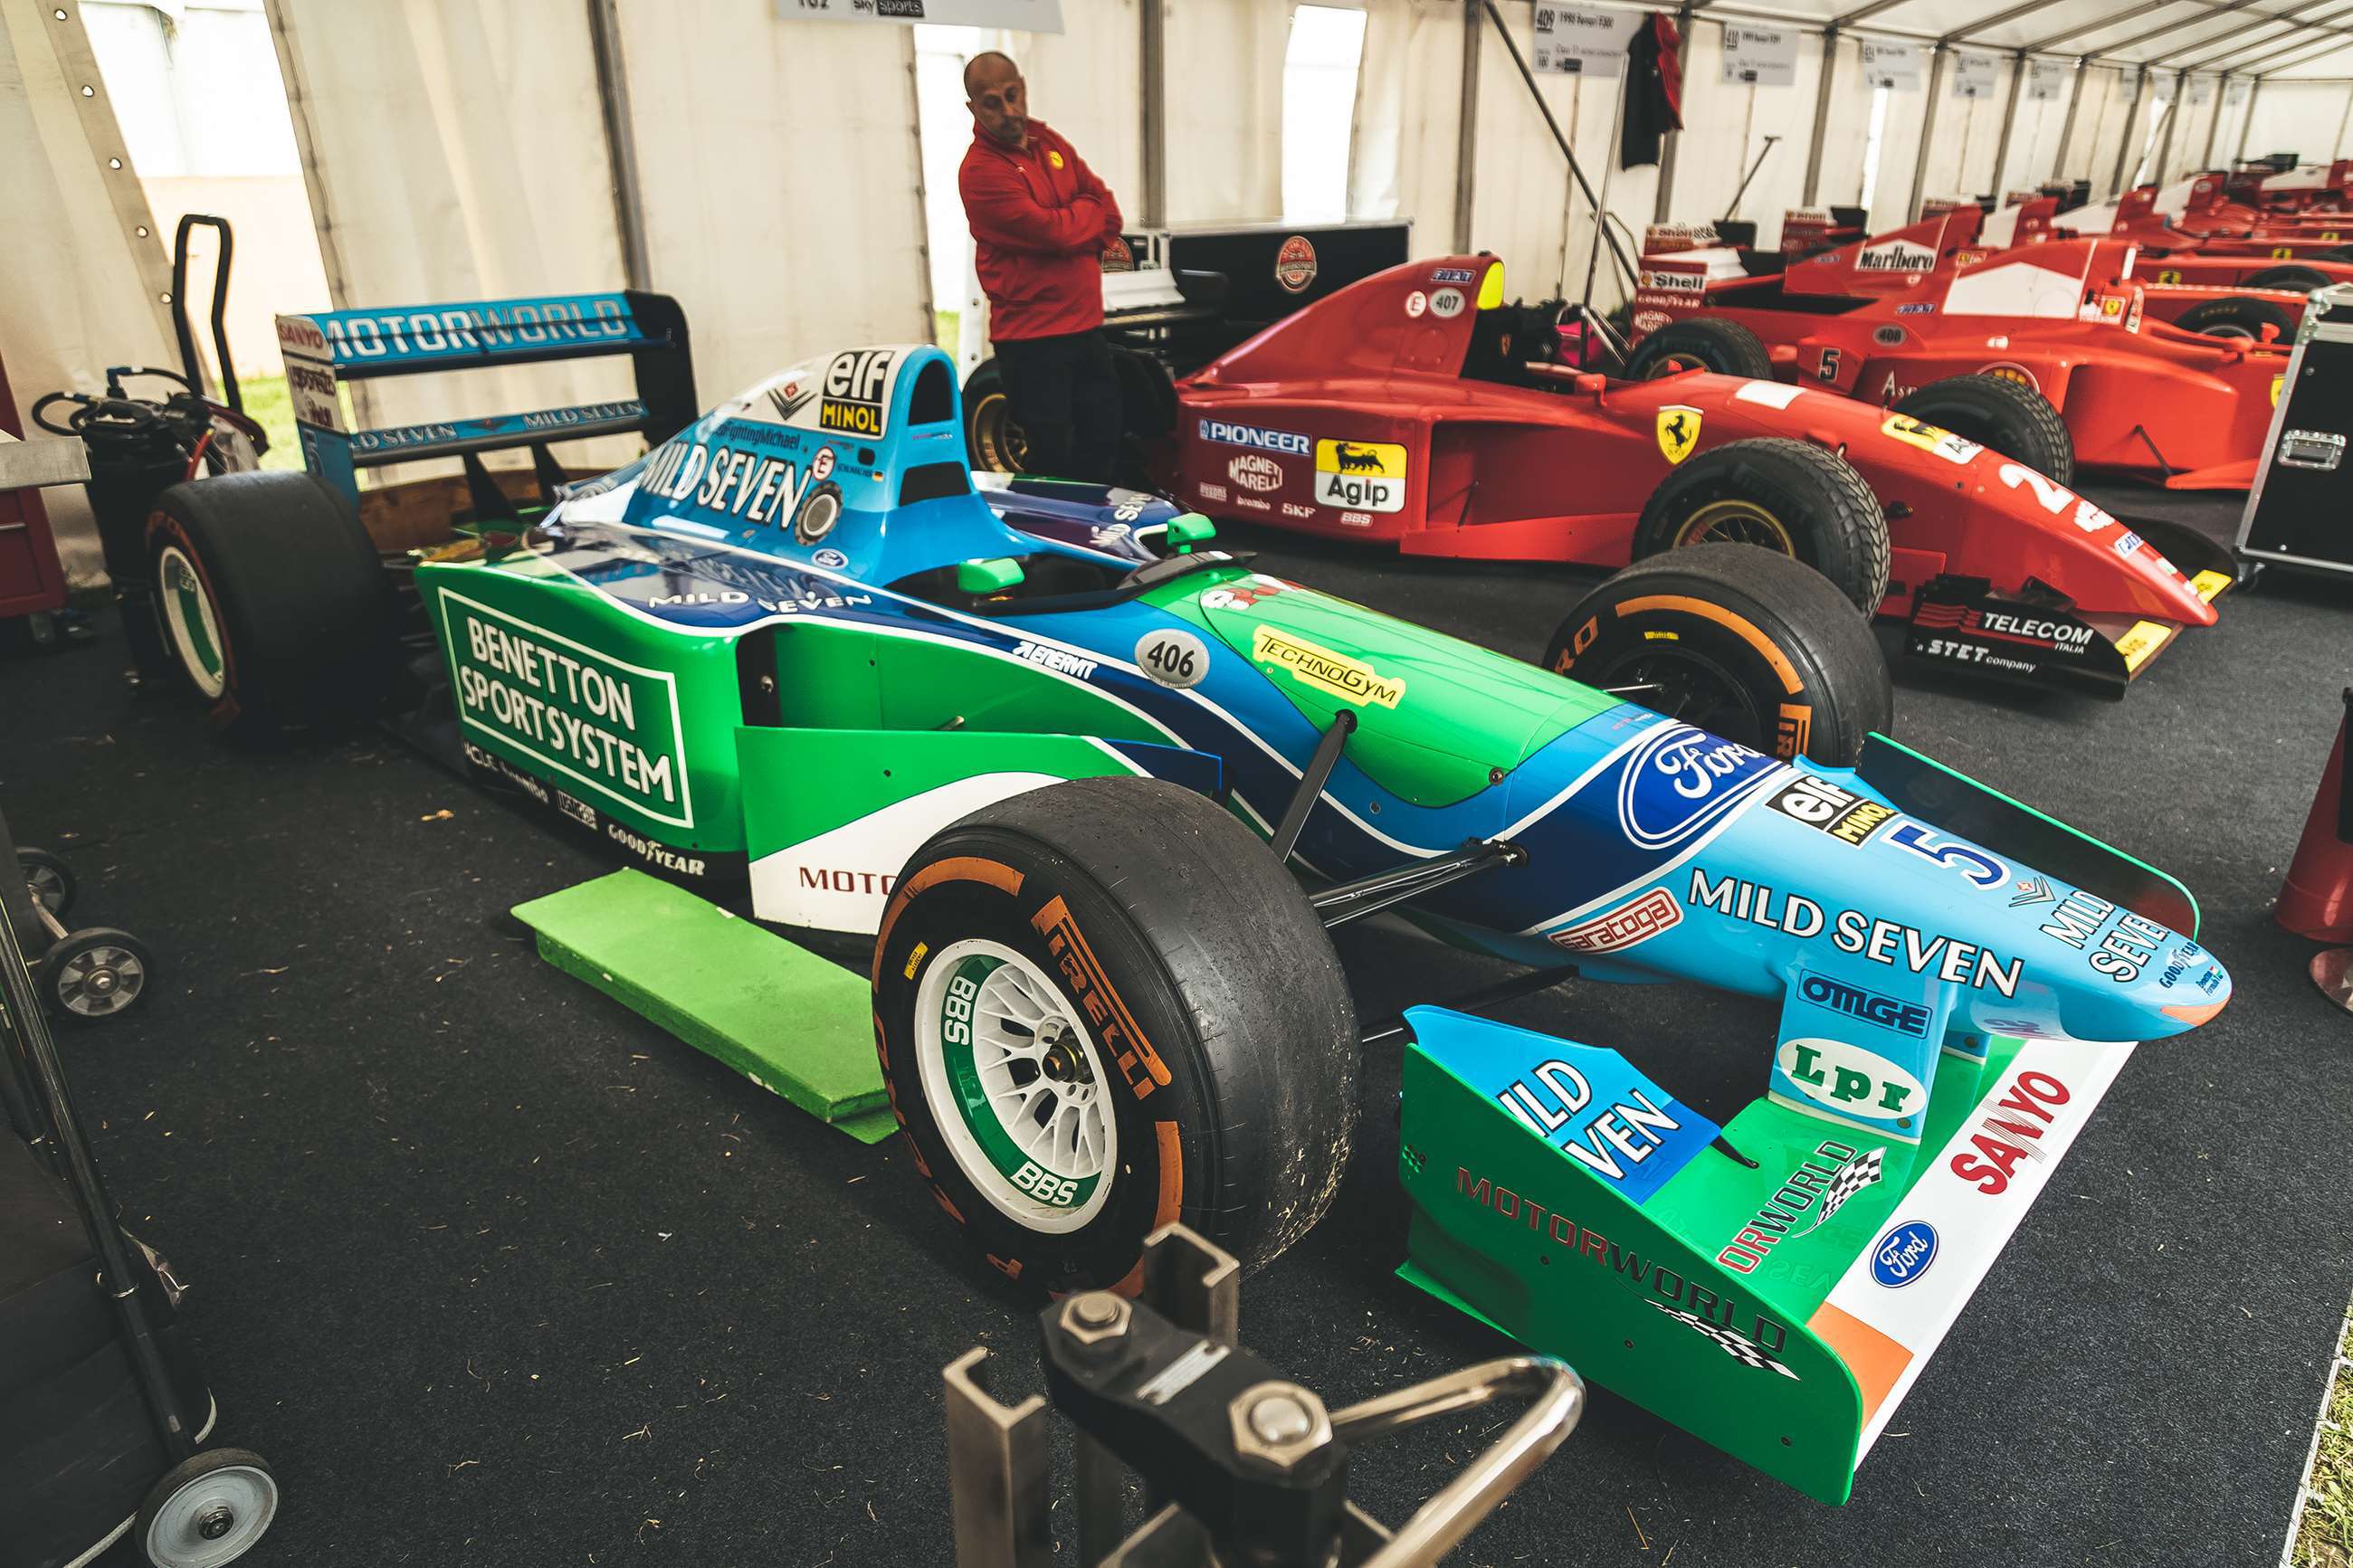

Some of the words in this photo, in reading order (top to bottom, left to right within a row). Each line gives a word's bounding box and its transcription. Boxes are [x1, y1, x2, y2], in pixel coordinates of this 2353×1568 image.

[1655, 273, 1704, 290] Shell
[1860, 245, 1934, 271] Marlboro
[1411, 296, 1422, 311] E
[1435, 295, 1459, 310] 407
[279, 323, 324, 349] SANYO
[324, 299, 628, 360] MOTORWORLD
[825, 350, 895, 401] elf
[1818, 347, 1841, 384] 5
[350, 426, 379, 451] LD
[379, 422, 459, 448] SEVEN
[522, 410, 577, 431] MILD
[577, 400, 645, 424] SEVEN
[822, 404, 881, 433] MINOL
[1210, 422, 1310, 454] PIONEER
[636, 440, 709, 501] MILD
[696, 444, 814, 531] SEVEN
[1228, 454, 1283, 478] MAGNETI
[1228, 468, 1283, 492] MARELLI
[1236, 495, 1272, 510] brembo
[1281, 502, 1317, 518] SKF
[1327, 474, 1390, 507] Agip
[1340, 512, 1372, 527] BBS
[648, 590, 751, 609] MILD
[757, 594, 873, 614] SEVEN
[1555, 614, 1599, 675] RO
[1984, 612, 2095, 645] TELECOM
[2054, 641, 2084, 654] ITALIA
[465, 615, 636, 731] BENETTON
[1148, 641, 1196, 678] 406
[1928, 639, 1989, 662] STET
[1986, 655, 2036, 673] company
[1781, 774, 1856, 822] elf
[606, 823, 706, 877] GOODYEAR
[1881, 821, 2009, 889] 5
[1688, 869, 1825, 940] MILD
[1833, 911, 2024, 999] SEVEN
[2038, 889, 2118, 950] MILD
[2088, 912, 2171, 984] SEVE
[2158, 941, 2200, 989] GOODYEAR
[942, 974, 977, 1046] BBS
[1030, 894, 1173, 1100] PIRELLI
[1496, 1059, 1593, 1138] ILD
[1791, 1043, 1912, 1112] Lpr
[1560, 1087, 1683, 1181] VEN
[1948, 1070, 2072, 1196] SANYO
[1009, 1159, 1080, 1206] BBS
[1715, 1140, 1858, 1275] ORWORLD
[1456, 1165, 1787, 1354] MOTORWORLD
[1879, 1231, 1929, 1278] Ford
